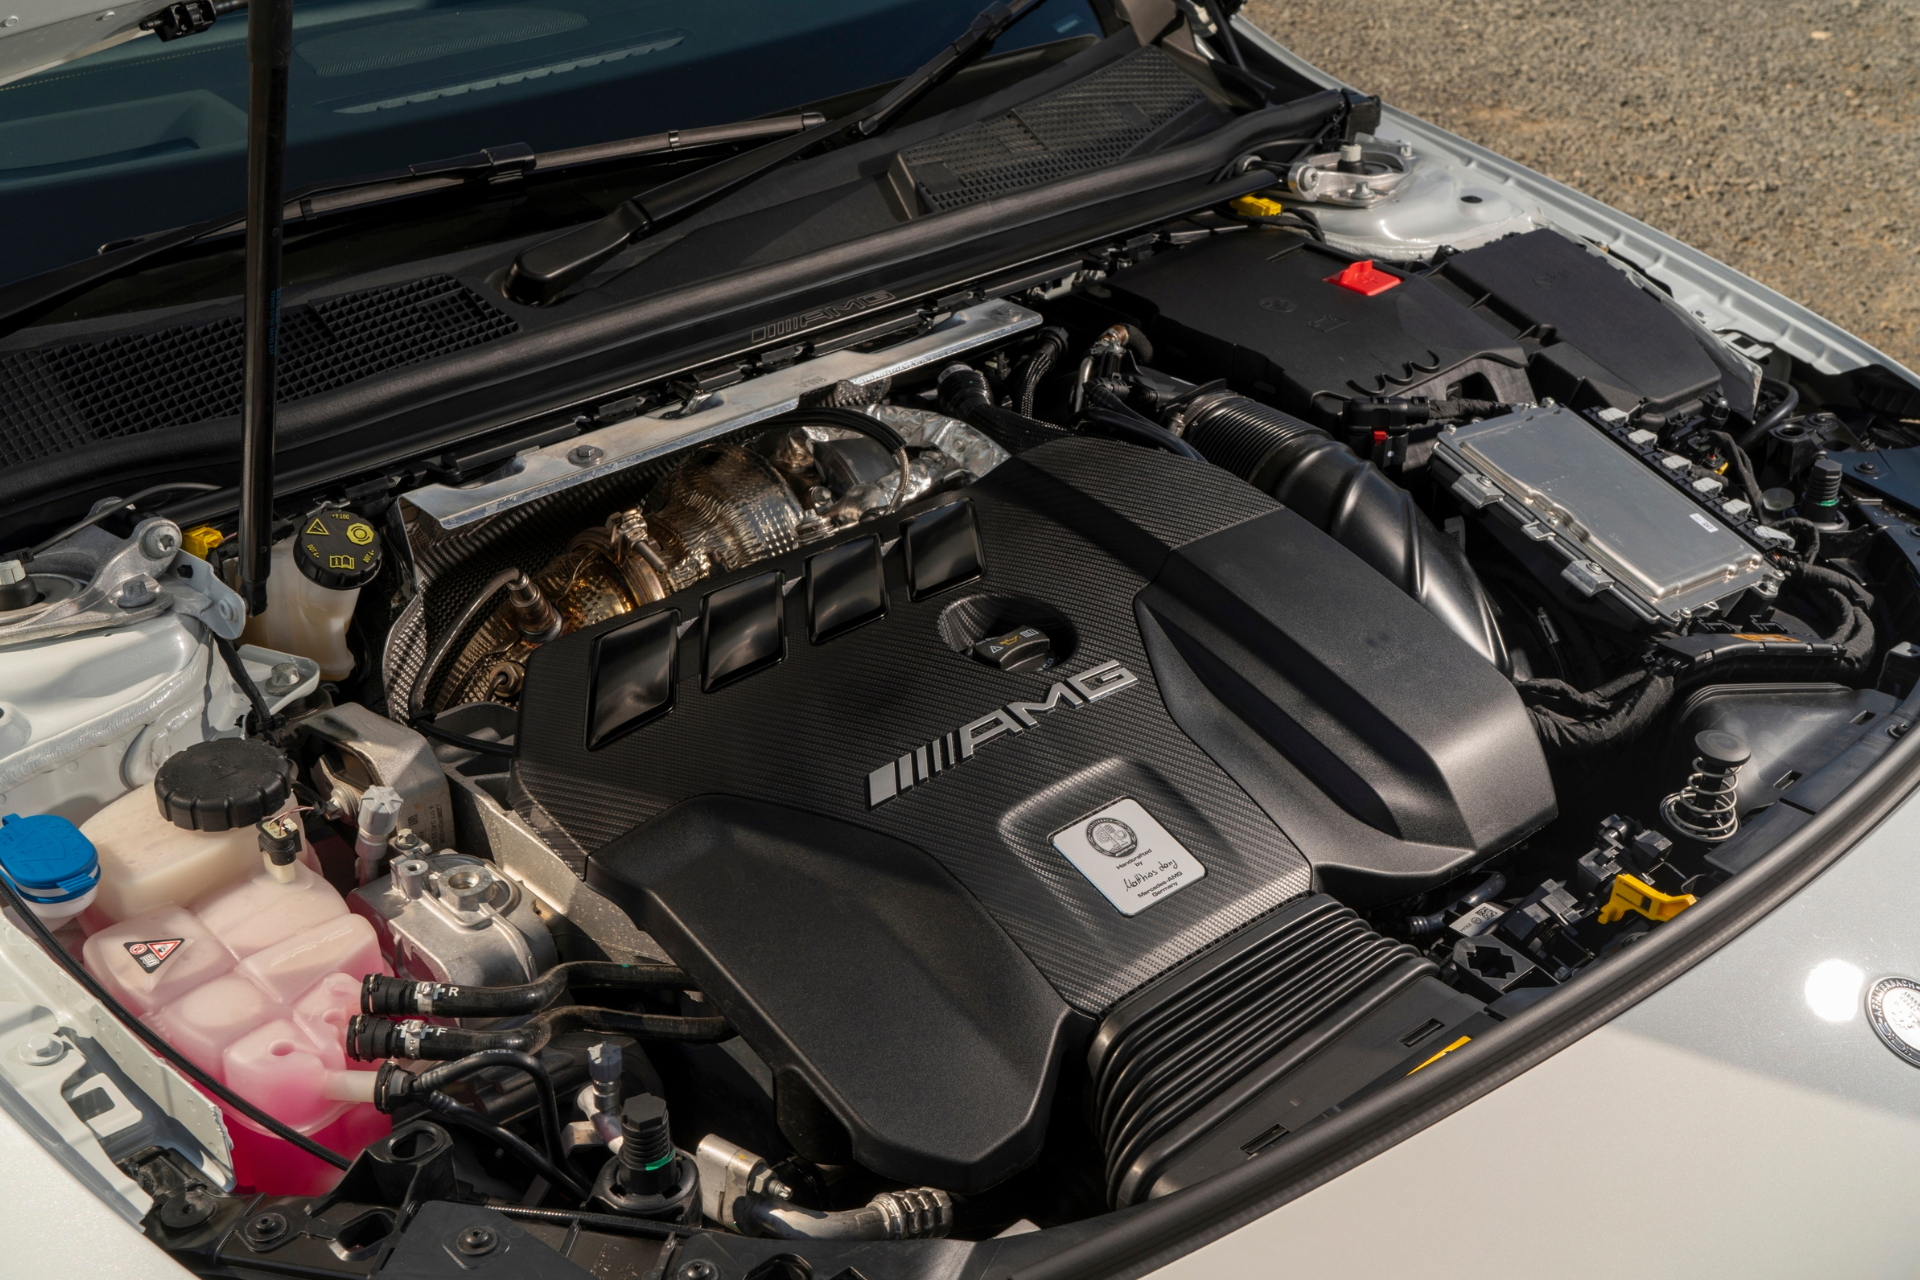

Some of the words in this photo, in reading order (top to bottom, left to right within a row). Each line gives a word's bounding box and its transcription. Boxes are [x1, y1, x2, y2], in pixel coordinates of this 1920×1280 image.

[800, 289, 896, 328] AMG
[957, 659, 1139, 763] AMG
[1116, 848, 1152, 870] Handcrafted
[1137, 871, 1183, 898] Mercedes-AMG
[1151, 882, 1178, 897] Germany
[448, 986, 460, 997] R
[436, 1027, 448, 1037] F
